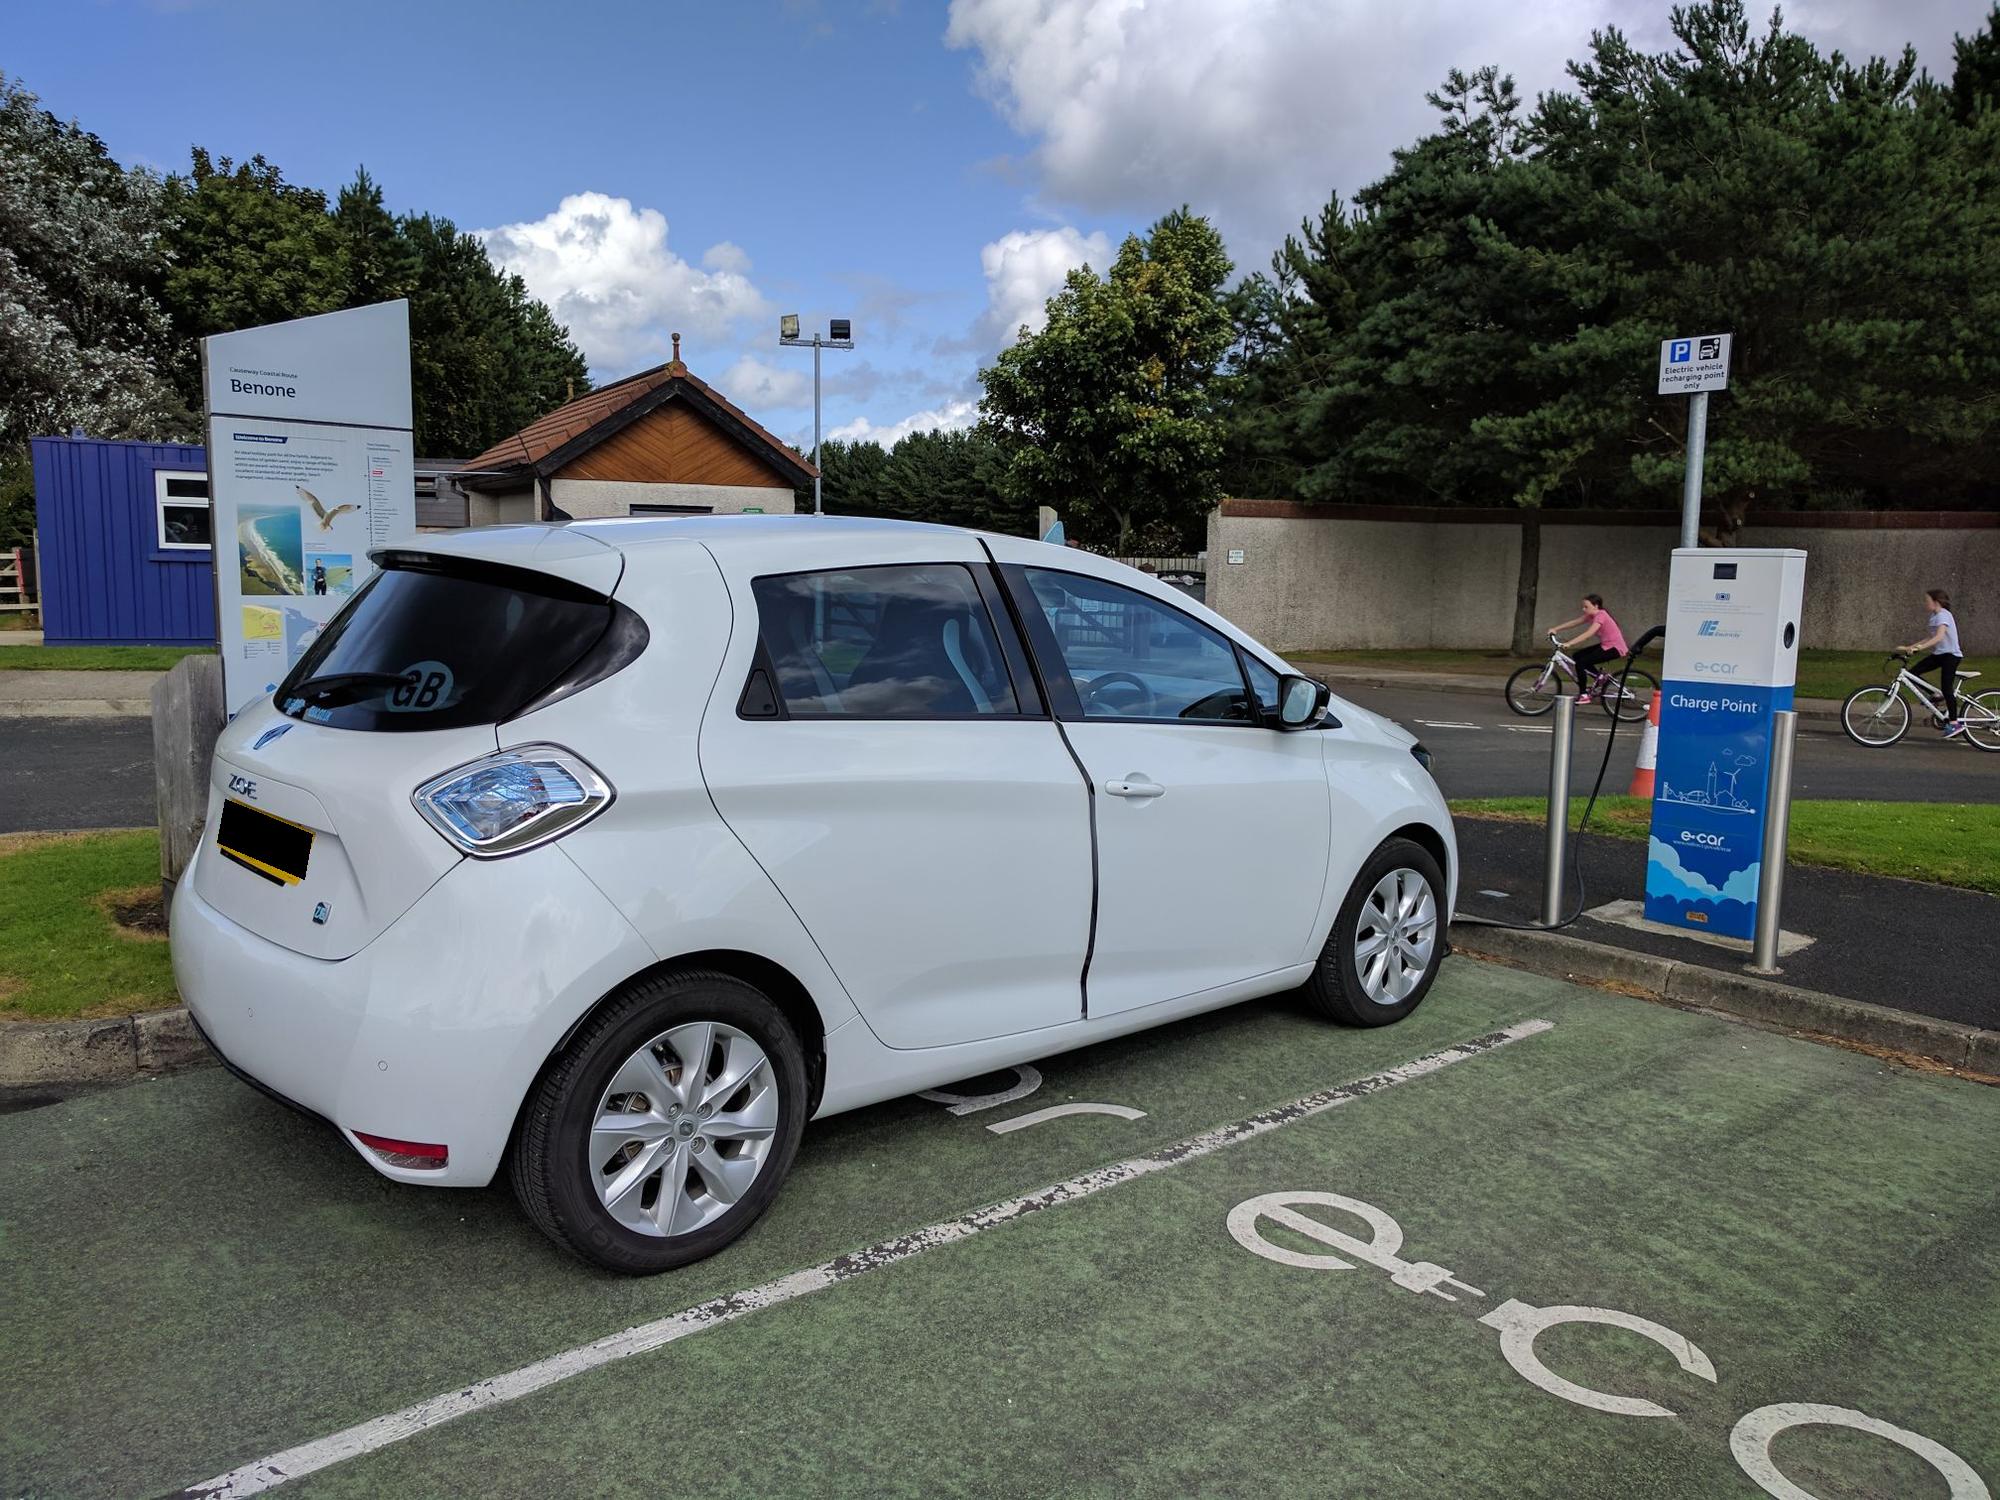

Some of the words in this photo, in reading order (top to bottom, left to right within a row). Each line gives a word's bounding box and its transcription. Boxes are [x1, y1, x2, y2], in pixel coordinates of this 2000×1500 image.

[1675, 343, 1688, 361] P
[1662, 374, 1702, 383] recharging
[1704, 371, 1724, 379] point
[1665, 366, 1693, 374] Electric
[1696, 363, 1723, 371] vehicle
[230, 379, 296, 398] Benone
[1694, 662, 1739, 674] e-car
[392, 670, 446, 708] GB
[1671, 694, 1718, 713] Charge
[1721, 697, 1758, 713] Point
[229, 773, 257, 800] ZOE
[1681, 831, 1725, 846] e-car
